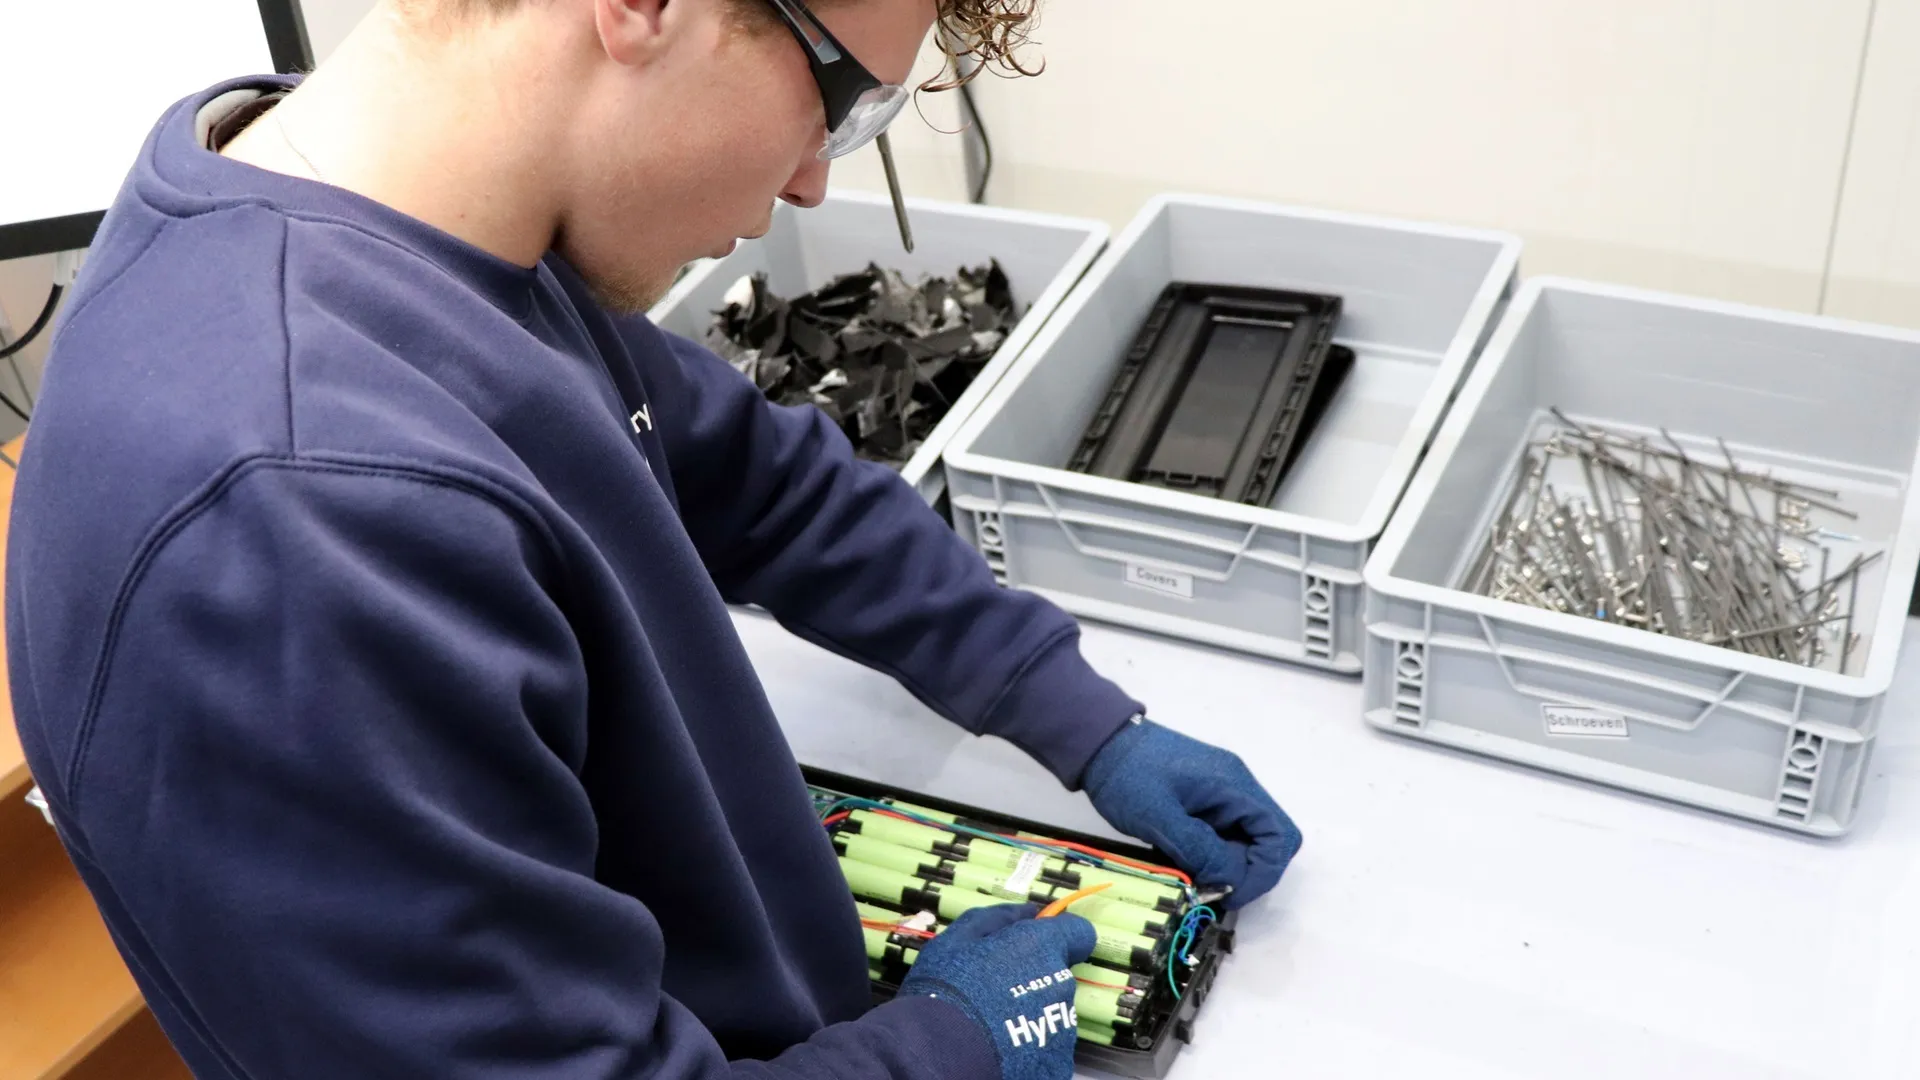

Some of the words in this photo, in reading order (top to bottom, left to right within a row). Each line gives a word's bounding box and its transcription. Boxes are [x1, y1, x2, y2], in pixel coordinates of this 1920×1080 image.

[1135, 566, 1178, 588] Covers
[1547, 713, 1624, 729] Schroeven
[1009, 975, 1052, 998] 11-819
